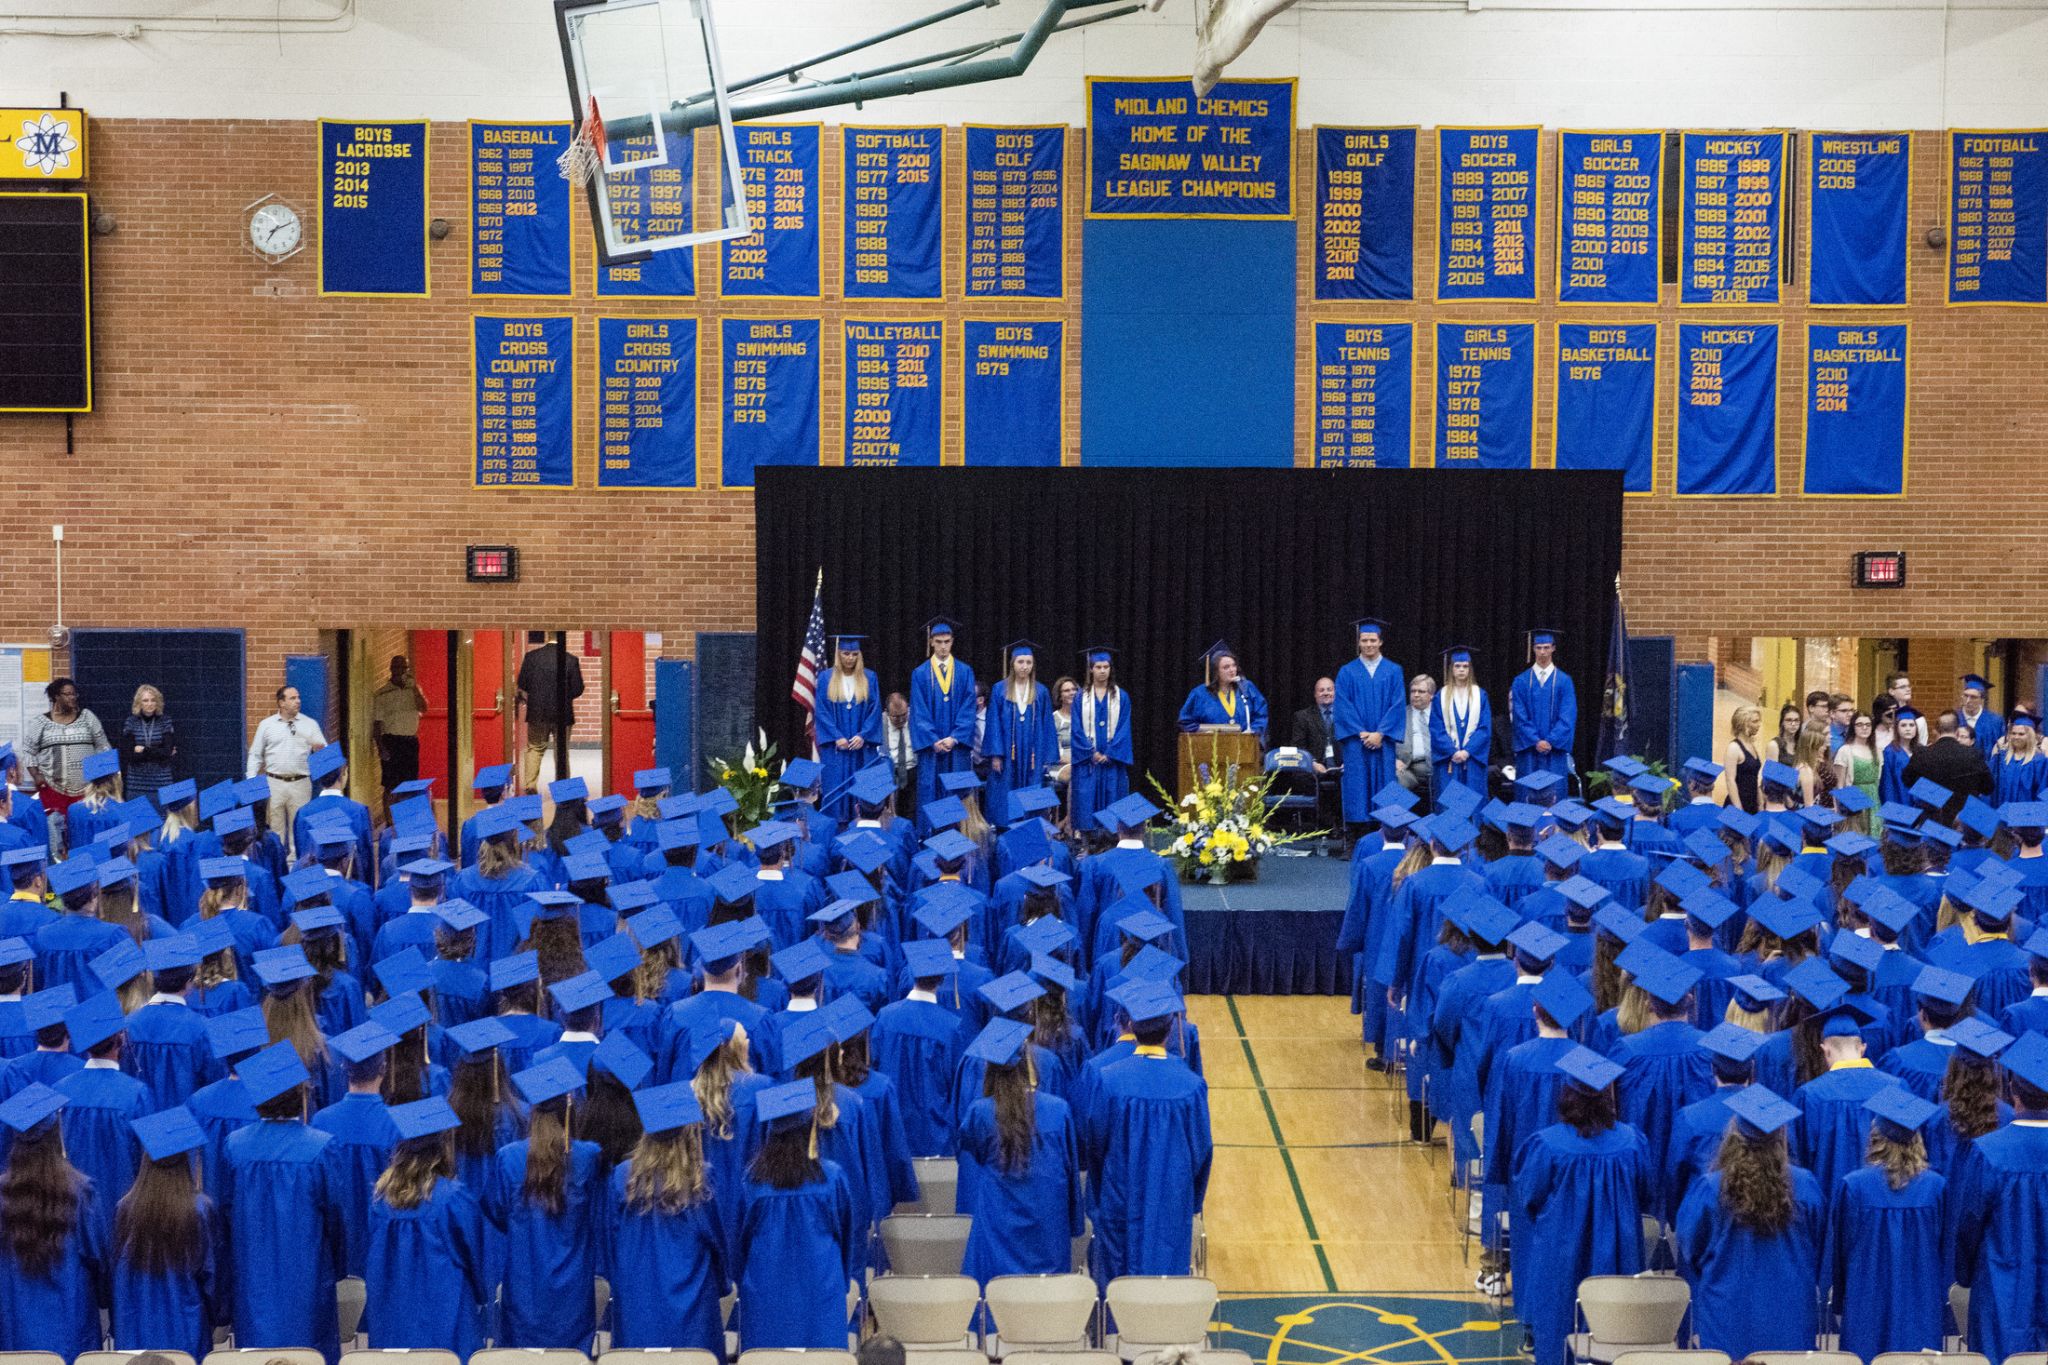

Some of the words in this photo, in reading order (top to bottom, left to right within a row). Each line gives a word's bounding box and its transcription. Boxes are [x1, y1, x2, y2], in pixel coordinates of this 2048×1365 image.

[1114, 97, 1188, 116] MIDLAND
[1196, 98, 1269, 117] CHEMICS
[354, 126, 393, 143] BOYS
[483, 129, 558, 145] BASEBALL
[748, 130, 792, 146] GIRLS
[855, 133, 930, 149] SOFTBALL
[995, 134, 1034, 149] BOYS
[1130, 125, 1178, 143] HOME
[1186, 125, 1209, 143] OF
[1219, 126, 1252, 145] THE
[1344, 134, 1390, 149] GIRLS
[1469, 134, 1509, 149] BOYS
[34, 133, 61, 154] M
[336, 142, 412, 158] LACROSSE
[1590, 138, 1633, 154] GIRLS
[1705, 140, 1761, 156] HOCKEY
[1821, 139, 1901, 156] WRESTLING
[1963, 138, 2039, 153] FOOTBALL
[478, 147, 504, 159] 1962
[747, 148, 793, 164] TRACK
[995, 152, 1033, 167] GOLF
[1346, 152, 1385, 167] GOLF
[1460, 152, 1517, 168] SOCCER
[334, 160, 371, 176] 2013
[896, 153, 931, 169] 2001
[1119, 153, 1192, 171] SAGINAW
[1201, 153, 1262, 173] VALLEY
[1583, 156, 1640, 172] SOCCER
[774, 167, 804, 183] 2011
[855, 169, 889, 184] 1977
[896, 168, 930, 184] 2015
[1491, 170, 1529, 186] 2006
[1613, 174, 1651, 189] 2003
[1695, 175, 1727, 190] 1987
[1818, 174, 1856, 190] 2009
[333, 176, 370, 193] 2014
[649, 185, 683, 199] 1997
[773, 184, 806, 199] 2013
[1030, 183, 1058, 196] 2004
[1105, 179, 1172, 198] LEAGUE
[1181, 179, 1276, 199] CHAMPIONS
[1959, 184, 1982, 196] 1971
[333, 193, 369, 209] 2015
[507, 188, 535, 201] 2010
[855, 186, 888, 201] 1979
[1491, 186, 1529, 202] 2007
[1612, 191, 1651, 207] 2007
[1733, 191, 1773, 207] 2000
[505, 201, 538, 216] 2012
[773, 198, 805, 213] 2014
[855, 202, 889, 218] 1980
[1030, 196, 1058, 209] 2015
[1323, 202, 1362, 218] 2000
[972, 211, 997, 223] 1970
[1452, 204, 1480, 219] 1991
[1491, 203, 1529, 219] 2009
[1573, 206, 1606, 222] 1990
[1611, 207, 1649, 222] 2008
[1732, 208, 1768, 224] 2001
[478, 215, 504, 227] 1970
[646, 217, 684, 233] 2007
[773, 215, 805, 230] 2015
[855, 219, 888, 235] 1987
[1322, 219, 1362, 235] 2002
[1493, 219, 1523, 234] 2011
[478, 229, 503, 241] 1972
[1611, 223, 1649, 239] 2009
[1733, 225, 1771, 241] 2002
[972, 238, 996, 251] 1974
[1450, 238, 1483, 253] 1994
[1492, 234, 1525, 248] 2012
[1570, 239, 1608, 254] 2000
[1610, 239, 1649, 255] 2015
[1987, 237, 2016, 249] 2007
[729, 249, 768, 265] 2002
[1325, 249, 1360, 264] 2010
[1447, 254, 1485, 269] 2004
[1986, 248, 2012, 261] 2012
[1493, 261, 1525, 276] 2014
[1571, 256, 1604, 271] 2001
[1693, 258, 1726, 273] 1994
[728, 265, 765, 280] 2004
[1326, 265, 1355, 280] 2011
[971, 279, 997, 291] 1977
[1569, 273, 1607, 288] 2002
[1693, 274, 1727, 289] 1997
[1732, 274, 1770, 289] 2007
[503, 322, 543, 337] BOYS
[626, 323, 669, 339] GIRLS
[749, 324, 793, 339] GIRLS
[847, 325, 941, 341] VOLLEYBALL
[995, 326, 1033, 341] BOYS
[1345, 328, 1383, 344] BOYS
[1464, 328, 1508, 344] GIRLS
[1588, 329, 1627, 344] BOYS
[1701, 329, 1755, 345] HOCKEY
[1837, 331, 1878, 346] GIRLS
[499, 341, 549, 356] CROSS
[623, 342, 672, 357] CROSS
[736, 341, 807, 357] SWIMMING
[856, 343, 885, 358] 1981
[895, 343, 931, 359] 2010
[977, 344, 1049, 360] SWIMMING
[1338, 346, 1391, 361] TENNIS
[1460, 346, 1512, 362] TENNIS
[1561, 347, 1652, 362] BASKETBALL
[1689, 347, 1723, 362] 2010
[1813, 348, 1902, 363] BASKETBALL
[490, 359, 557, 374] COUNTRY
[615, 358, 679, 373] COUNTRY
[856, 359, 890, 374] 1994
[896, 358, 925, 373] 2011
[975, 361, 1010, 376] 1979
[1448, 364, 1482, 379] 1976
[1569, 365, 1602, 381] 1976
[1691, 361, 1721, 376] 2011
[634, 376, 662, 388] 2000
[895, 373, 929, 388] 2012
[1816, 367, 1848, 382] 2010
[511, 377, 537, 389] 1977
[1351, 377, 1376, 389] 1977
[1447, 380, 1481, 395] 1977
[1690, 375, 1723, 390] 2012
[634, 390, 659, 401] 2001
[1815, 383, 1849, 398] 2012
[733, 392, 767, 407] 1977
[857, 392, 890, 407] 1997
[1447, 397, 1481, 412] 1978
[1690, 391, 1722, 406] 2013
[1815, 397, 1848, 412] 2014
[634, 404, 662, 415] 2004
[733, 408, 767, 423] 1979
[852, 408, 892, 425] 2000
[482, 417, 508, 430] 1972
[1321, 418, 1346, 430] 1970
[1446, 413, 1480, 428] 1980
[481, 431, 508, 443] 1973
[604, 431, 630, 442] 1997
[852, 425, 891, 441] 2002
[1446, 429, 1479, 444] 1984
[482, 445, 507, 457] 1974
[510, 445, 538, 457] 2000
[1320, 445, 1346, 457] 1973
[511, 458, 537, 470] 2001
